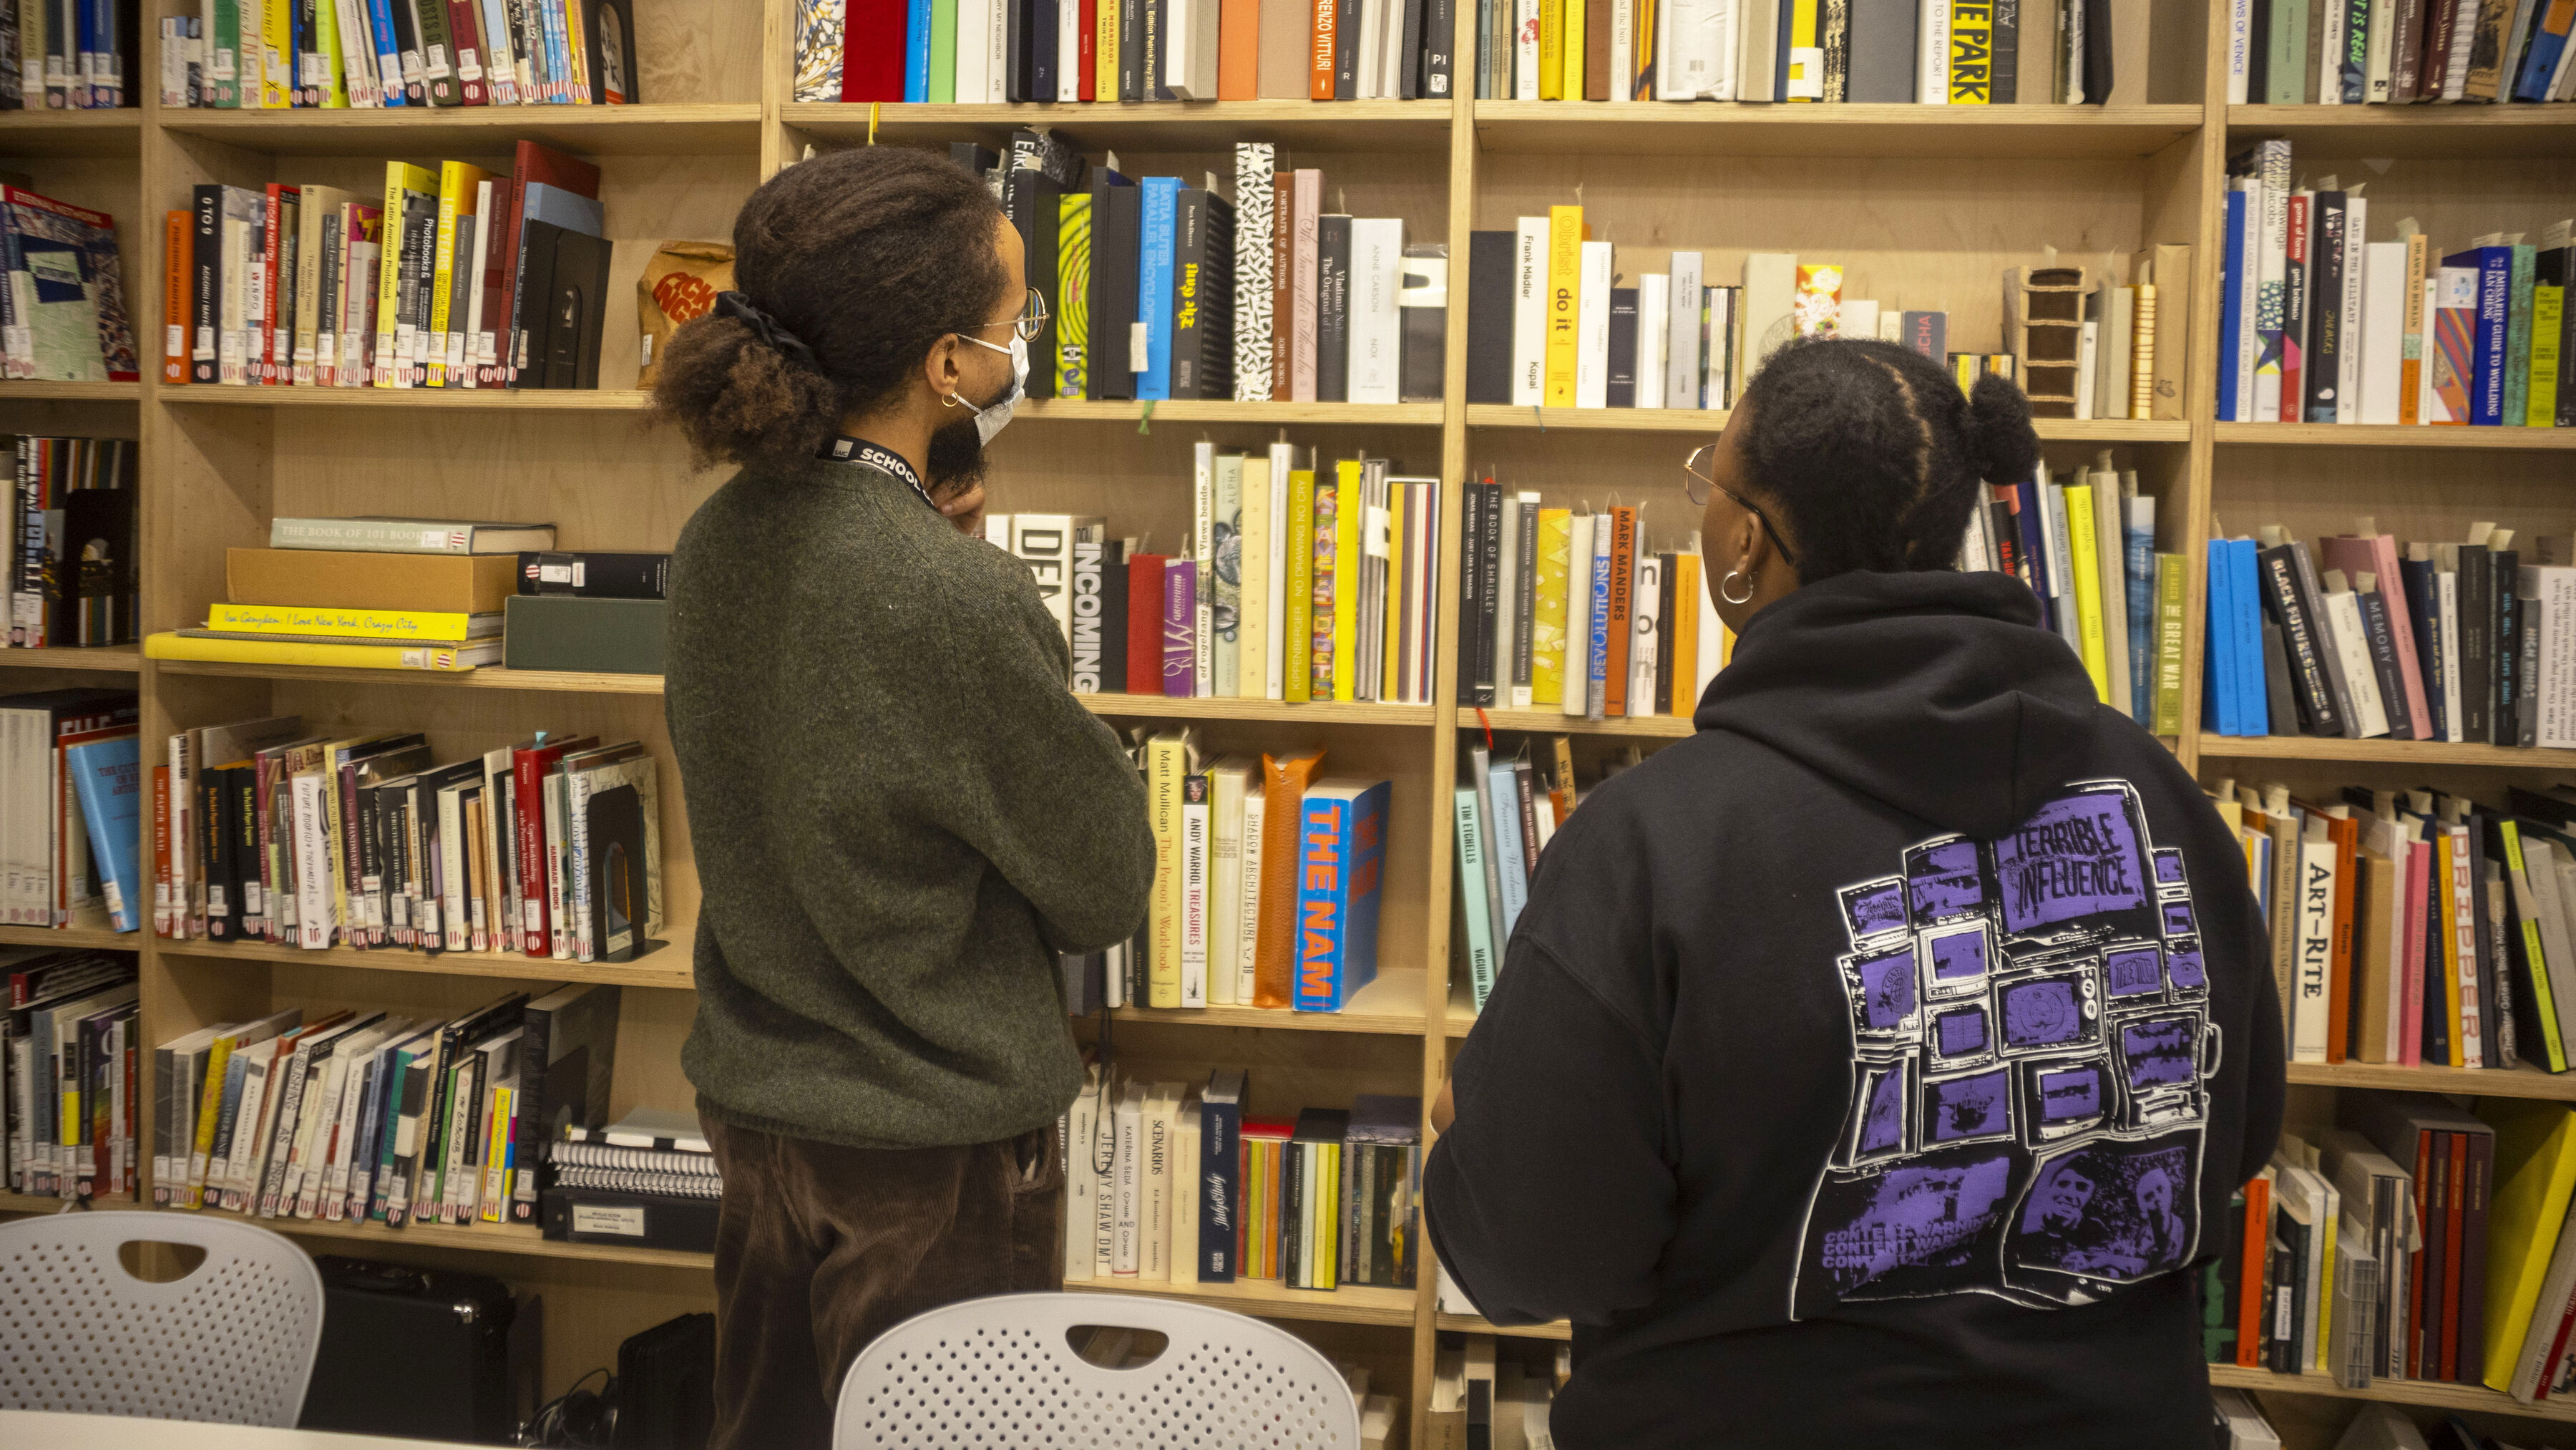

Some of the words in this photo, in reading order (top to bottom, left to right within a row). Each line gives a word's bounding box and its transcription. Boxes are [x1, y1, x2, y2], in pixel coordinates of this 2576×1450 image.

[1935, 4, 1942, 16] TO
[2235, 21, 2245, 34] OF
[1317, 34, 1331, 69] VITTURI
[1933, 41, 1942, 77] REPORT
[1953, 29, 1989, 101] PARK
[2234, 39, 2244, 75] VENICE
[202, 210, 213, 223] TO
[440, 198, 455, 231] LIGHT
[1146, 184, 1157, 245] PARALLEL
[1158, 184, 1171, 220] BATIA
[2293, 203, 2305, 224] game
[385, 223, 394, 258] American
[421, 218, 433, 271] Photobooks
[1158, 225, 1170, 266] SUTER
[1280, 238, 1286, 249] OF
[1558, 216, 1575, 275] Obrist
[2351, 218, 2361, 238] GAYS
[438, 234, 452, 270] YEARS
[1324, 258, 1332, 274] The
[1523, 235, 1533, 263] Frank
[2293, 238, 2303, 258] forms
[2349, 256, 2358, 273] THE
[2351, 243, 2358, 253] IN
[1321, 277, 1332, 314] Original
[1335, 271, 1345, 311] Vladimir
[1523, 266, 1533, 298] Mädler
[2486, 271, 2494, 286] IAN
[1556, 288, 1572, 311] do
[2347, 278, 2357, 323] MILITARY
[2483, 289, 2494, 319] CHENG
[2492, 271, 2506, 323] EMISSARIES
[1556, 318, 1571, 331] it
[2491, 325, 2503, 351] GUIDE
[1528, 362, 1539, 389] Kopal
[2491, 354, 2500, 366] TO
[2487, 368, 2499, 416] WORLDING
[860, 447, 921, 492] SCHOOL
[1297, 480, 1307, 501] CRY
[1488, 491, 1498, 509] THE
[1296, 506, 1306, 521] NO
[1487, 515, 1497, 541] BOOK
[1617, 511, 1631, 549] MARK
[283, 526, 305, 537] THE
[308, 527, 342, 538] BOOK
[346, 530, 361, 539] OF
[1294, 526, 1305, 576] DRAWING
[1487, 547, 1496, 559] OF
[1294, 580, 1304, 596] NO
[1484, 564, 1496, 613] SHRIGLEY
[1614, 555, 1629, 621] MANDERS
[294, 614, 311, 626] Love
[315, 615, 333, 626] New
[364, 617, 393, 633] Crazy
[396, 618, 417, 636] City
[1073, 542, 1102, 694] INCOMING
[2270, 559, 2295, 606] BLACK
[2285, 607, 2315, 668] FUTURES
[1199, 610, 1209, 663] vogelsang
[1292, 607, 1303, 689] KIPPENBERGER
[2163, 623, 2181, 659] GREAT
[2368, 601, 2392, 663] MEMORY
[2162, 664, 2180, 689] WAR
[1160, 750, 1171, 777] Matt
[1159, 782, 1171, 832] Mullican
[1460, 805, 1472, 820] TIM
[519, 829, 527, 852] Pierpont
[1190, 818, 1201, 843] ANDY
[1247, 814, 1259, 855] SHADOW
[1463, 824, 1476, 865] ETCHELLS
[2014, 812, 2123, 861] TERRIBLE
[519, 853, 528, 876] Morgan
[528, 842, 537, 882] Bookbindings
[550, 846, 559, 887] HANDMADE
[1159, 837, 1171, 862] That
[1189, 847, 1201, 886] WARHOL
[1306, 807, 1341, 892] THE
[521, 878, 530, 895] Library
[1244, 861, 1257, 943] ARCHITECTURE
[2018, 855, 2134, 915] INFLUENCE
[1189, 889, 1200, 945] TREASURES
[1158, 916, 1171, 972] Workbook
[1301, 902, 1337, 997] NAM
[2452, 834, 2479, 1038] DRIPPER
[1474, 948, 1488, 983] VACUUM
[1477, 985, 1490, 1006] DAYS
[285, 1043, 311, 1111] PUBLISHING
[1100, 1133, 1115, 1188] JEREMY
[1151, 1120, 1163, 1175] SCENARIOS
[1099, 1194, 1111, 1232] SHAW
[1098, 1239, 1111, 1265] DMT
